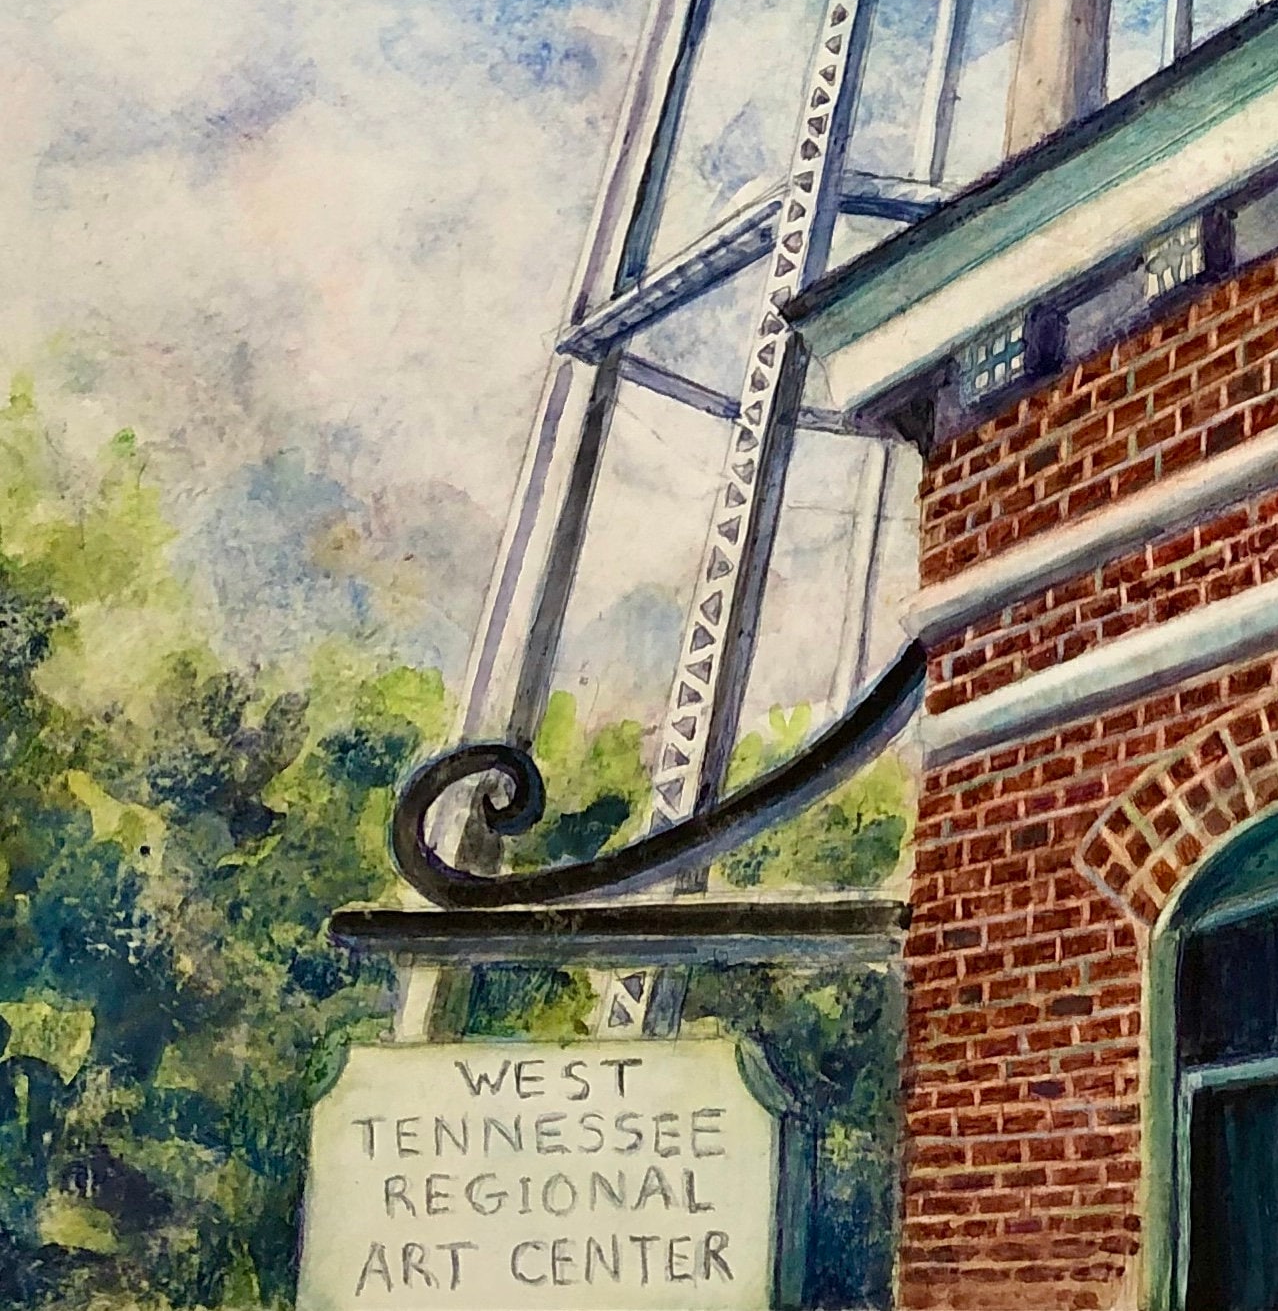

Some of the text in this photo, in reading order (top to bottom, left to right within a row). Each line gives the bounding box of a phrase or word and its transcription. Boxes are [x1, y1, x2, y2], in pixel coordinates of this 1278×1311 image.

[455, 1058, 643, 1101] WEST
[352, 1107, 726, 1160] TENNESSEE
[384, 1165, 716, 1218] REGIONAL
[355, 1230, 735, 1296] ART CENTER
